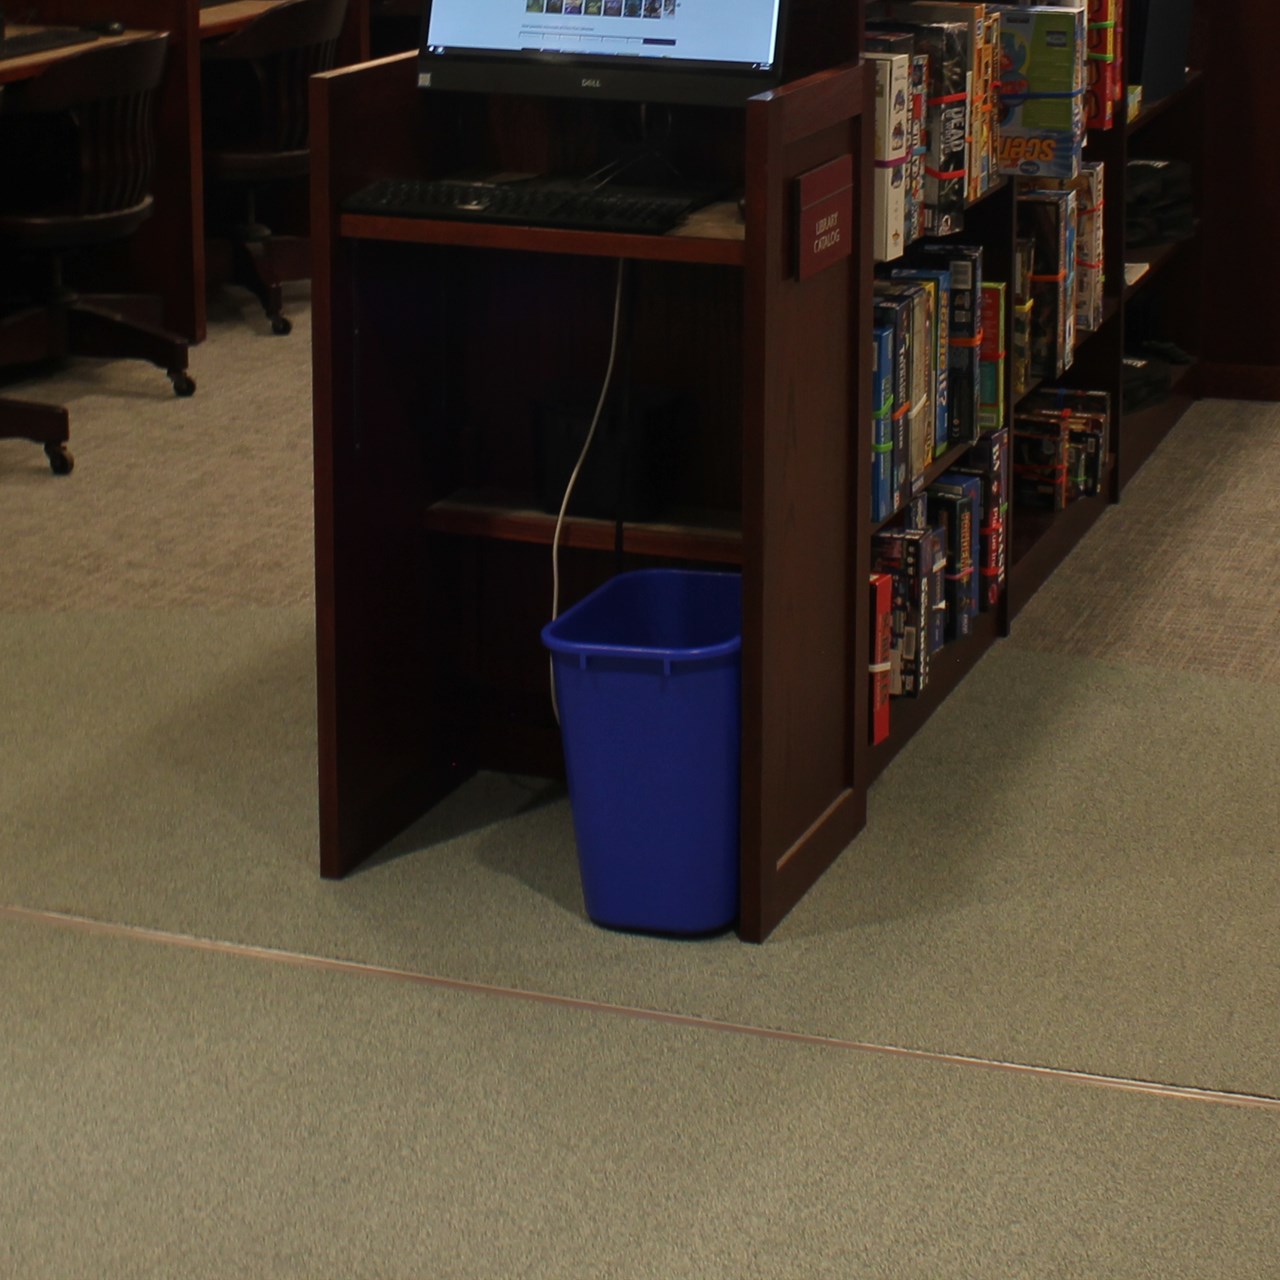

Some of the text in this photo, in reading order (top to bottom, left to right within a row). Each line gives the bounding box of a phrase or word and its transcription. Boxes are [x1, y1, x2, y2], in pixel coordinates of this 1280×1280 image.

[581, 78, 601, 88] DELL
[952, 105, 965, 152] DEAD
[815, 211, 839, 235] LIBRARY
[813, 229, 841, 253] CATALOG
[991, 507, 999, 550] Plaue
[960, 512, 971, 584] PANDEMC
